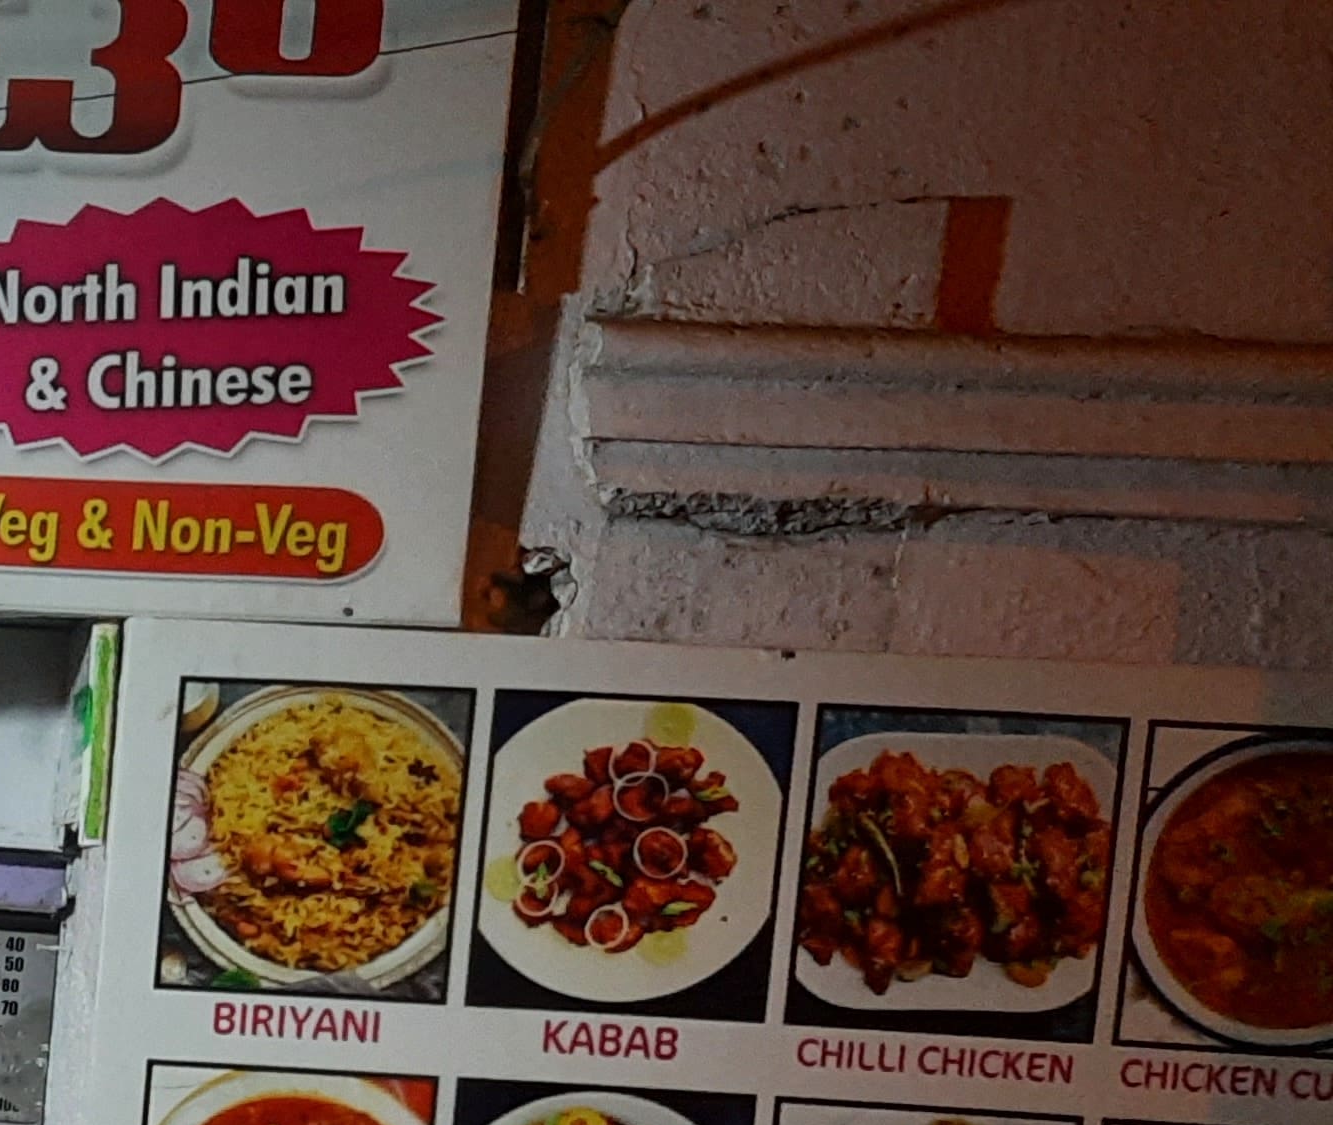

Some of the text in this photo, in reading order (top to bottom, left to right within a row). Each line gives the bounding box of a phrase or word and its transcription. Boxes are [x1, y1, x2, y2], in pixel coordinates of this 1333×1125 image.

[159, 263, 346, 319] Indian
[25, 354, 313, 413] & Chinese
[75, 502, 115, 551] &
[131, 499, 350, 573] Non-Veg
[5, 957, 25, 972] 50
[6, 937, 25, 952] 40
[1, 1000, 18, 1016] 70
[212, 1002, 382, 1045] BIRIYANI
[541, 1020, 680, 1061] KABAB
[796, 1037, 1075, 1085] CHILLI CHICKEN
[1120, 1058, 1277, 1098] CHICKEN
